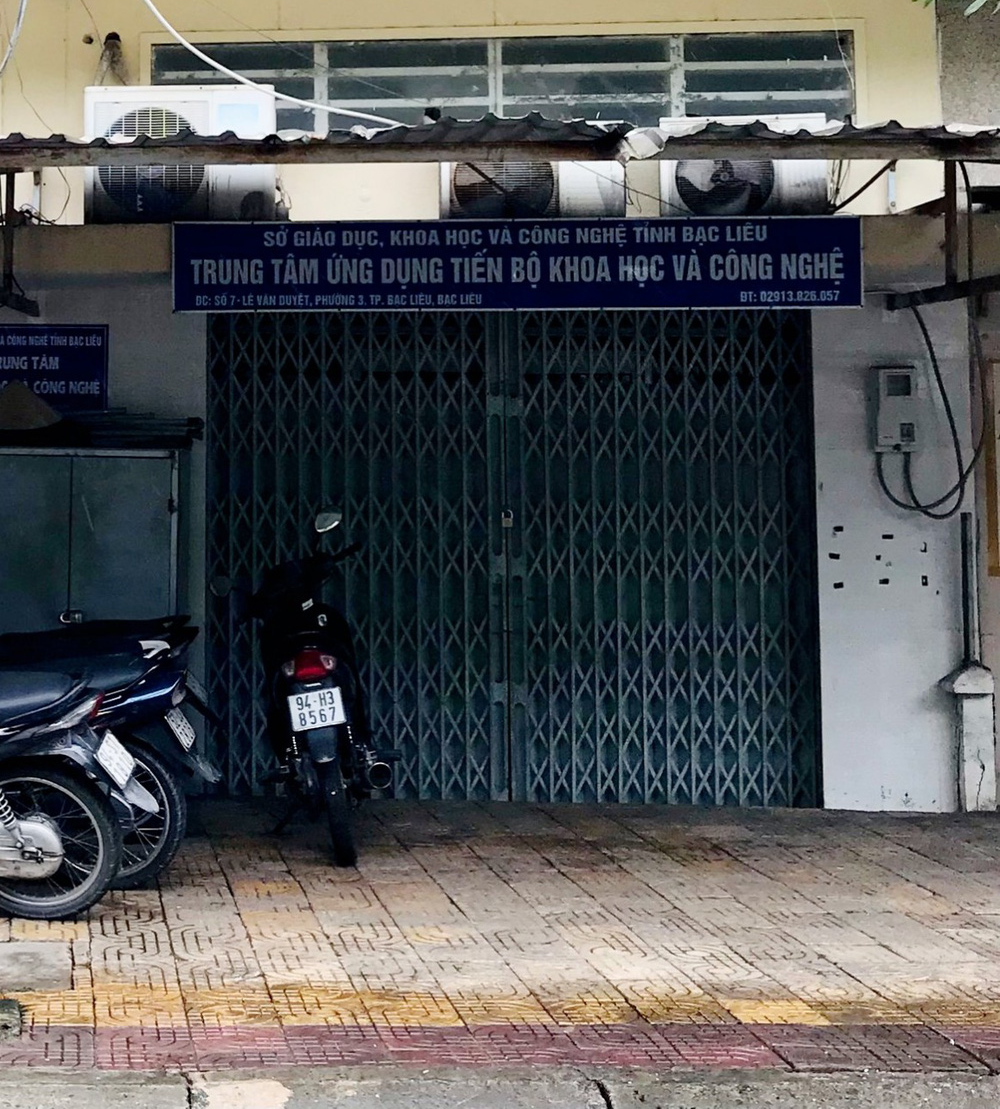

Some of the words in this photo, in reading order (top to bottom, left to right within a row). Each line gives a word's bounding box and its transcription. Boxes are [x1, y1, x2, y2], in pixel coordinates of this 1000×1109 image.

[263, 225, 289, 247] SỞ
[293, 227, 336, 247] GIÁO
[342, 230, 384, 250] DỤC,
[390, 229, 440, 246] KHOA
[445, 229, 483, 248] HỌC
[488, 225, 512, 245] VÀ
[518, 224, 570, 245] CÔNG
[576, 223, 628, 247] NGHỆ
[632, 221, 677, 243] TỈNH
[682, 226, 720, 246] BẠC
[726, 222, 768, 242] LIÊU
[190, 259, 264, 285] TRUNG
[271, 253, 319, 285] TÂM
[327, 252, 373, 285] ỨNG
[381, 259, 443, 290] DỤNG
[450, 249, 503, 283] TIẾN
[511, 251, 541, 288] BỘ
[549, 255, 612, 283] KHOA
[618, 254, 665, 288] HỌC
[672, 249, 703, 282] VÀ
[710, 249, 774, 282] CÔNG
[781, 247, 846, 285] NGHỆ
[215, 292, 229, 307] SỐ
[388, 294, 407, 307] BẠC
[437, 294, 457, 307] BẠC
[740, 291, 757, 303] ĐT:
[760, 290, 840, 303] 02913.826.057
[31, 354, 59, 369] TÂM
[296, 691, 335, 710] 94-H3
[299, 707, 336, 727] 8567
